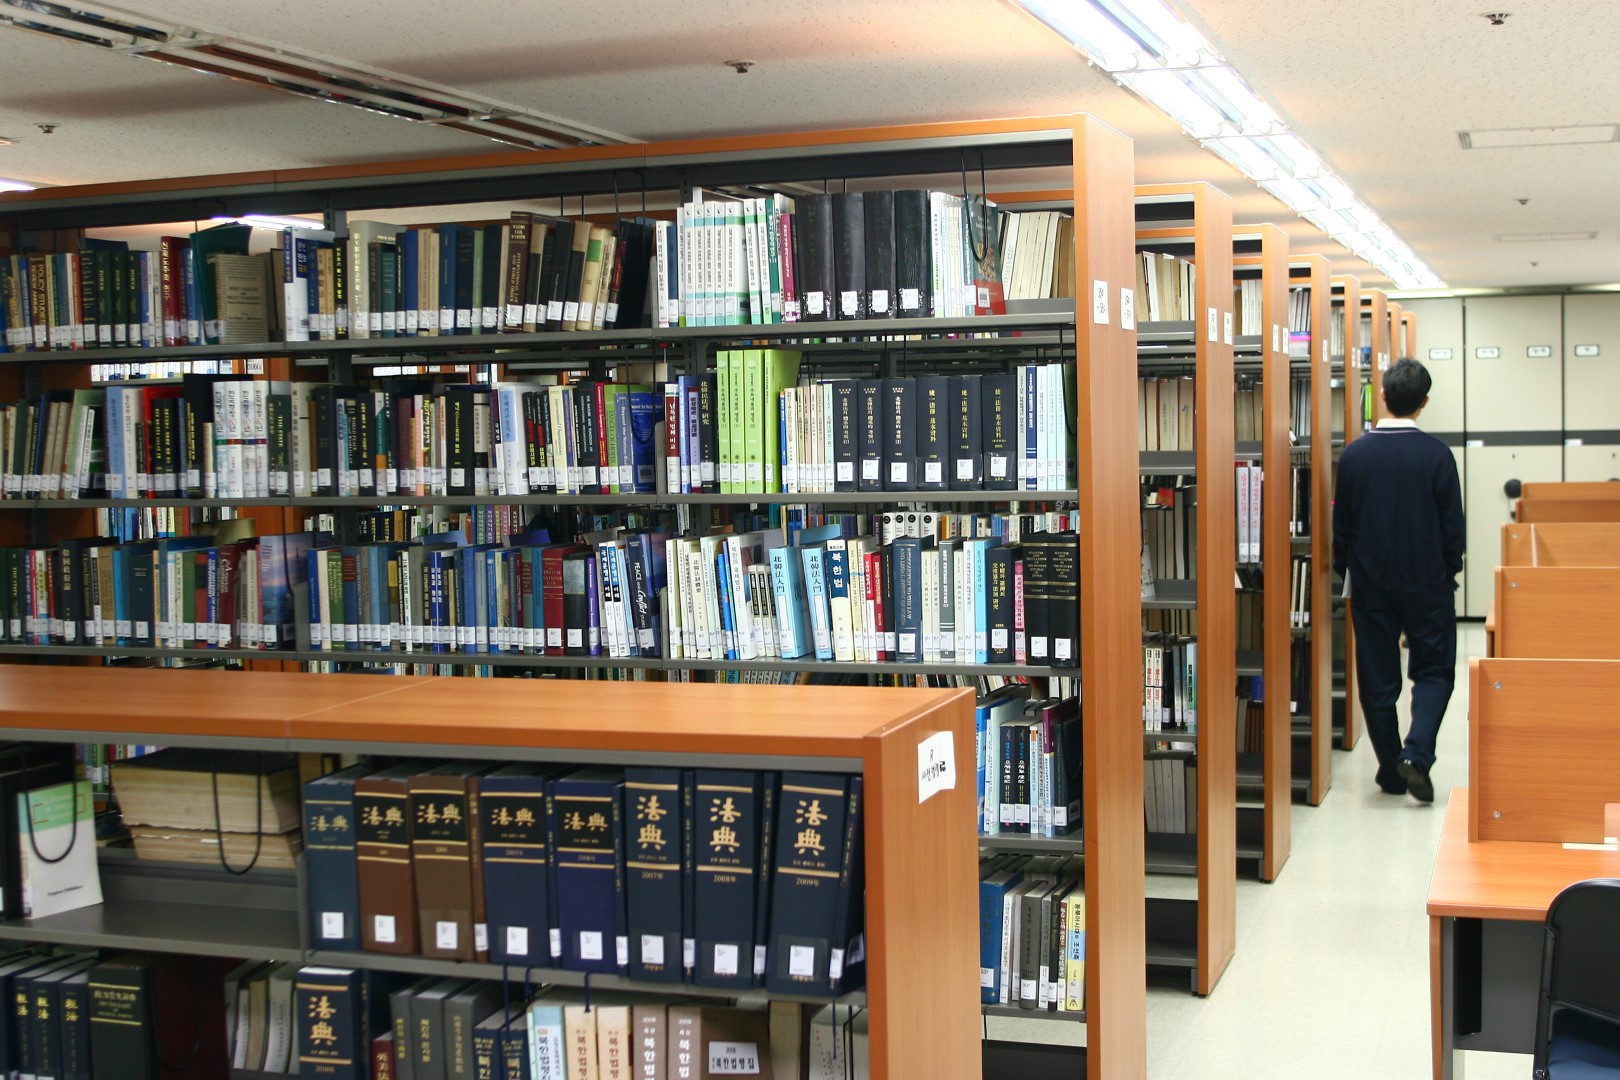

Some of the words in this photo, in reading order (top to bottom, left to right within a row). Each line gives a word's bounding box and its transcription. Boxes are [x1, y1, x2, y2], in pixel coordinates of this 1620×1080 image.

[634, 562, 642, 581] PEACE
[773, 555, 785, 593] 北韓法入門
[810, 555, 823, 593] 北韓法入門
[831, 552, 843, 589] 북한법
[636, 589, 648, 614] Conflict
[929, 748, 934, 762] R
[310, 814, 349, 832] 法典
[362, 805, 404, 827] 法典
[417, 803, 462, 824] 法典
[491, 806, 536, 827] 法典
[564, 811, 608, 832] 法典
[636, 794, 668, 851] 法典
[709, 796, 742, 853] 法典
[793, 799, 828, 857] 法典
[795, 878, 820, 888] 2009年
[308, 995, 337, 1046] 法典
[576, 1036, 589, 1080] 북한법령
[643, 1037, 657, 1080] 북한법
[715, 1057, 755, 1070] 북한법령집
